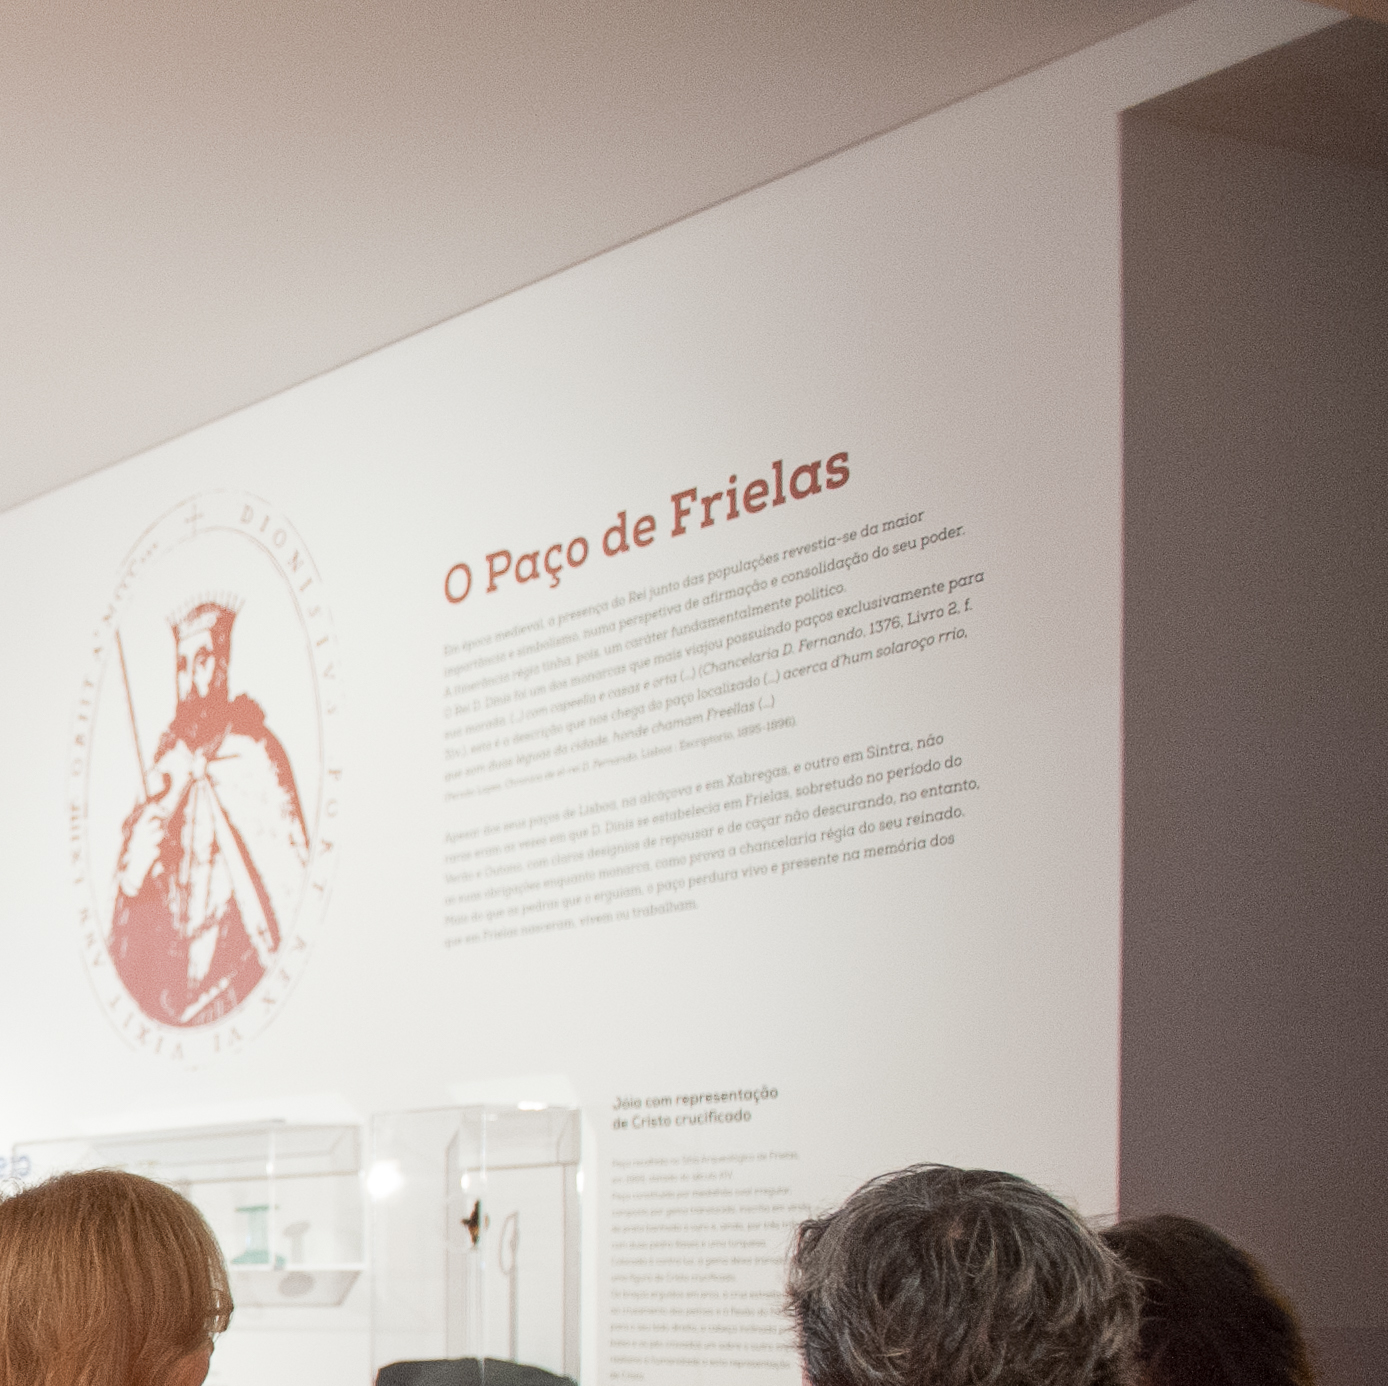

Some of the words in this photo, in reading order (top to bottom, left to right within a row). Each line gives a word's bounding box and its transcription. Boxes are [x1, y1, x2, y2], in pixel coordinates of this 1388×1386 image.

[443, 562, 473, 605] O
[485, 536, 590, 593] Paço
[601, 509, 657, 557] de
[669, 451, 851, 538] Frielas
[782, 529, 857, 561] revestia-se
[882, 510, 925, 533] maior
[781, 549, 868, 585] consolidação
[893, 537, 916, 554] seu
[726, 619, 791, 652] possuindo
[794, 609, 832, 634] paços
[836, 579, 944, 619] exclusivamente
[948, 570, 984, 595] para
[907, 606, 944, 626] Livro
[782, 659, 828, 681] acerca
[830, 648, 873, 669] d'hum
[804, 754, 839, 772] outro
[916, 731, 944, 749] não
[795, 772, 862, 797] sobretudo
[739, 830, 817, 855] chancelaria
[879, 816, 902, 831] seu
[745, 814, 779, 833] caçar
[784, 807, 809, 824] não
[781, 850, 838, 877] presente
[864, 836, 926, 859] memória
[930, 832, 955, 848] dos
[645, 1094, 672, 1108] com
[676, 1085, 779, 1106] representação
[613, 1117, 628, 1130] de
[632, 1114, 671, 1128] Cristo
[675, 1108, 752, 1125] crucificado
